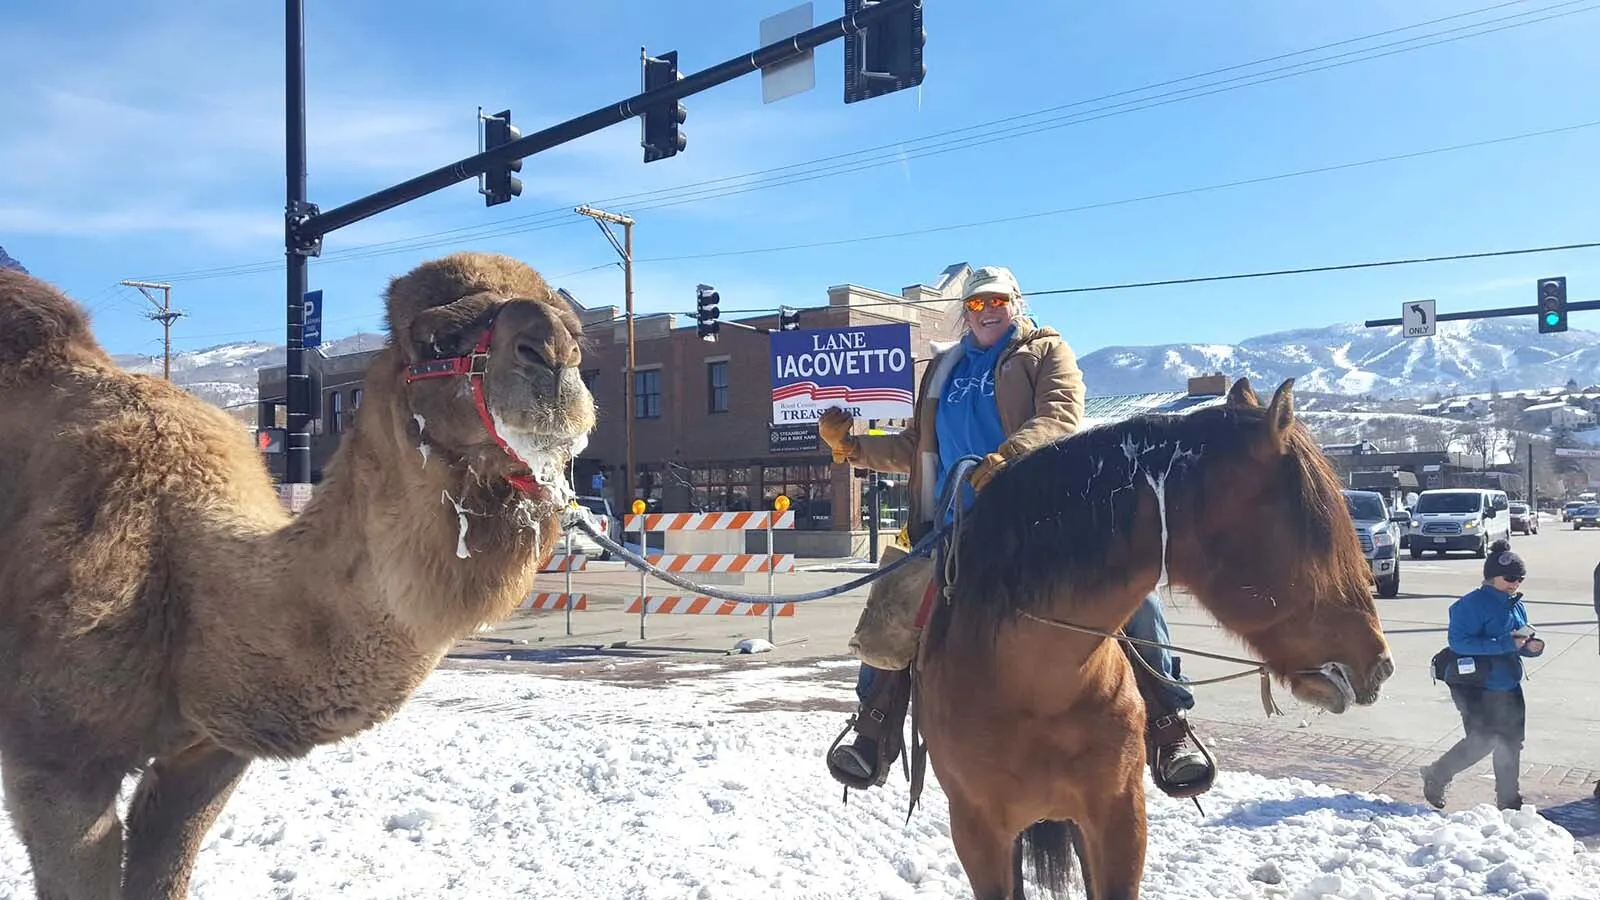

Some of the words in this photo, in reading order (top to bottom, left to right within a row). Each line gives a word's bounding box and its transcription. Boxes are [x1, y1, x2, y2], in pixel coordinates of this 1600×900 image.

[1409, 326, 1429, 335] ONLY
[812, 332, 867, 351] LANE
[776, 348, 906, 379] IACOVETTO
[781, 407, 861, 420] TREASR
